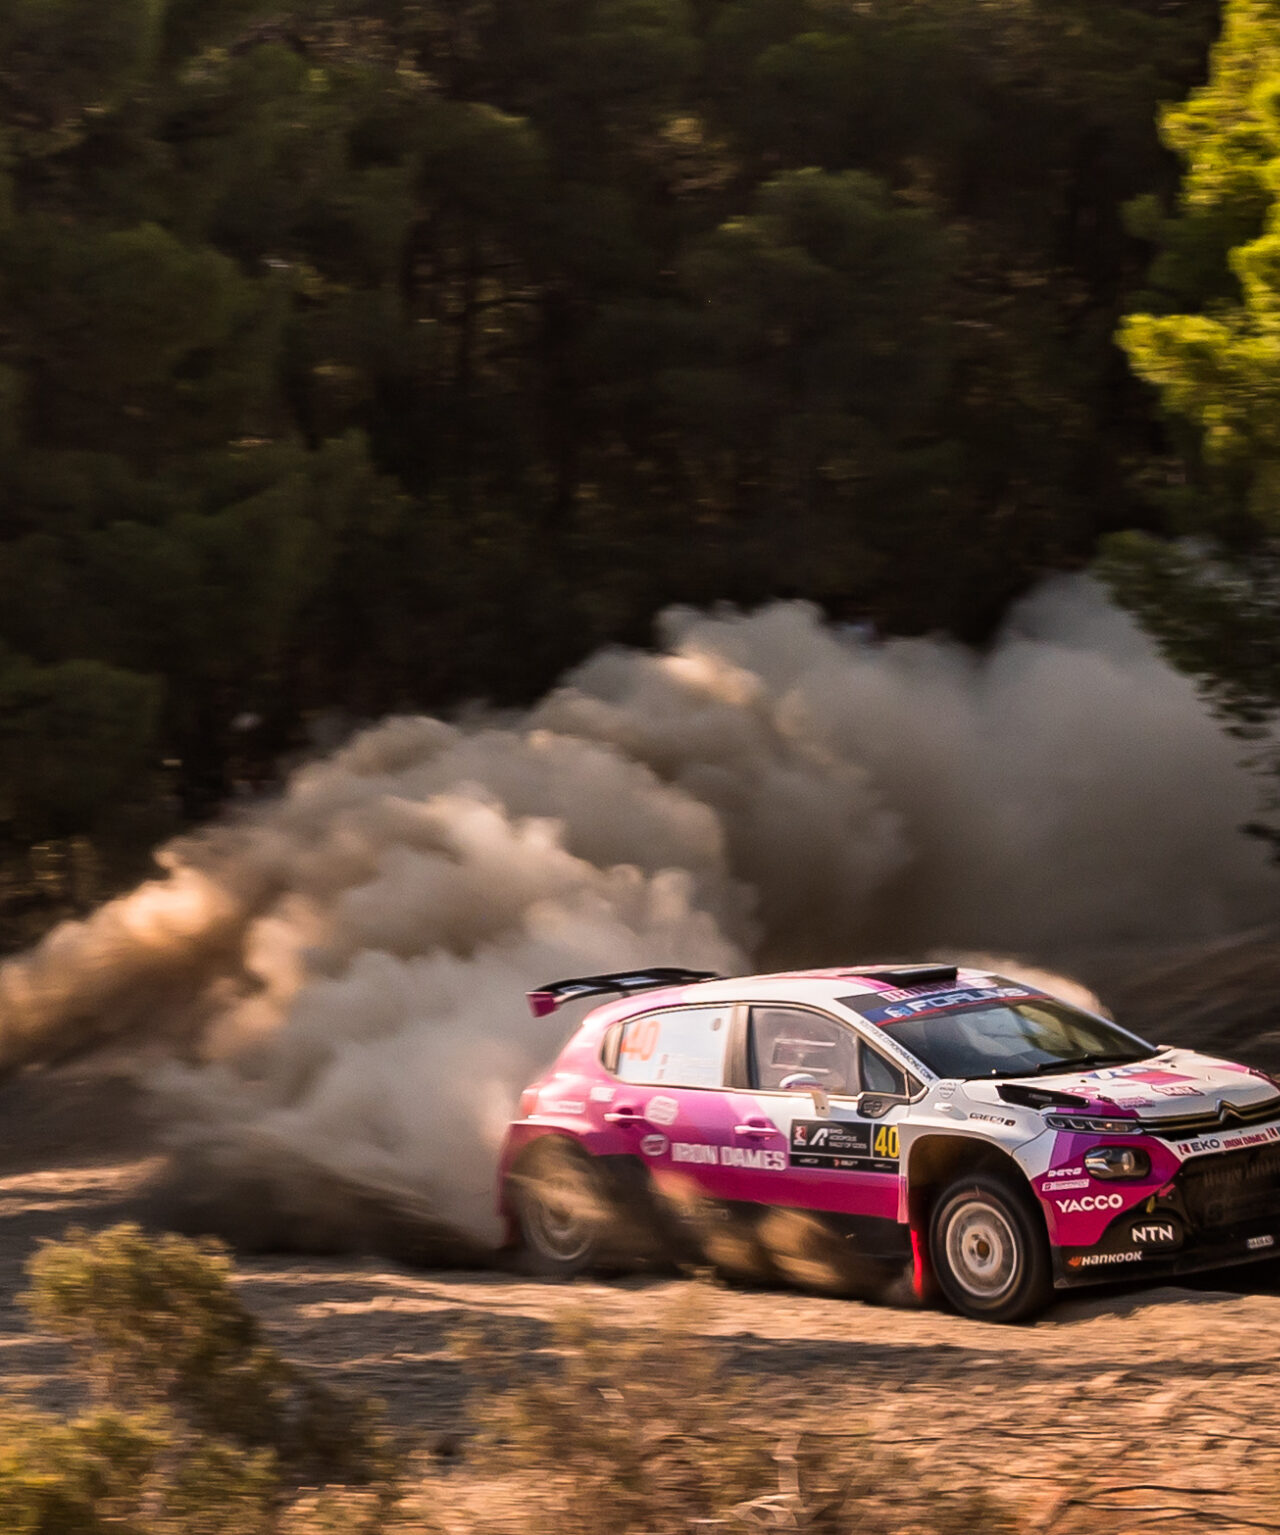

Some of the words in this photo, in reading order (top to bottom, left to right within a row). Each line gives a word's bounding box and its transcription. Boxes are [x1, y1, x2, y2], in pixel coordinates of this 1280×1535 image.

[621, 1020, 661, 1062] 40
[874, 1126, 900, 1158] 40
[1191, 1138, 1220, 1152] EKO
[671, 1142, 719, 1165] IRON
[720, 1146, 787, 1172] DAMES
[1056, 1193, 1123, 1213] YACCO
[1132, 1225, 1173, 1243] NTN
